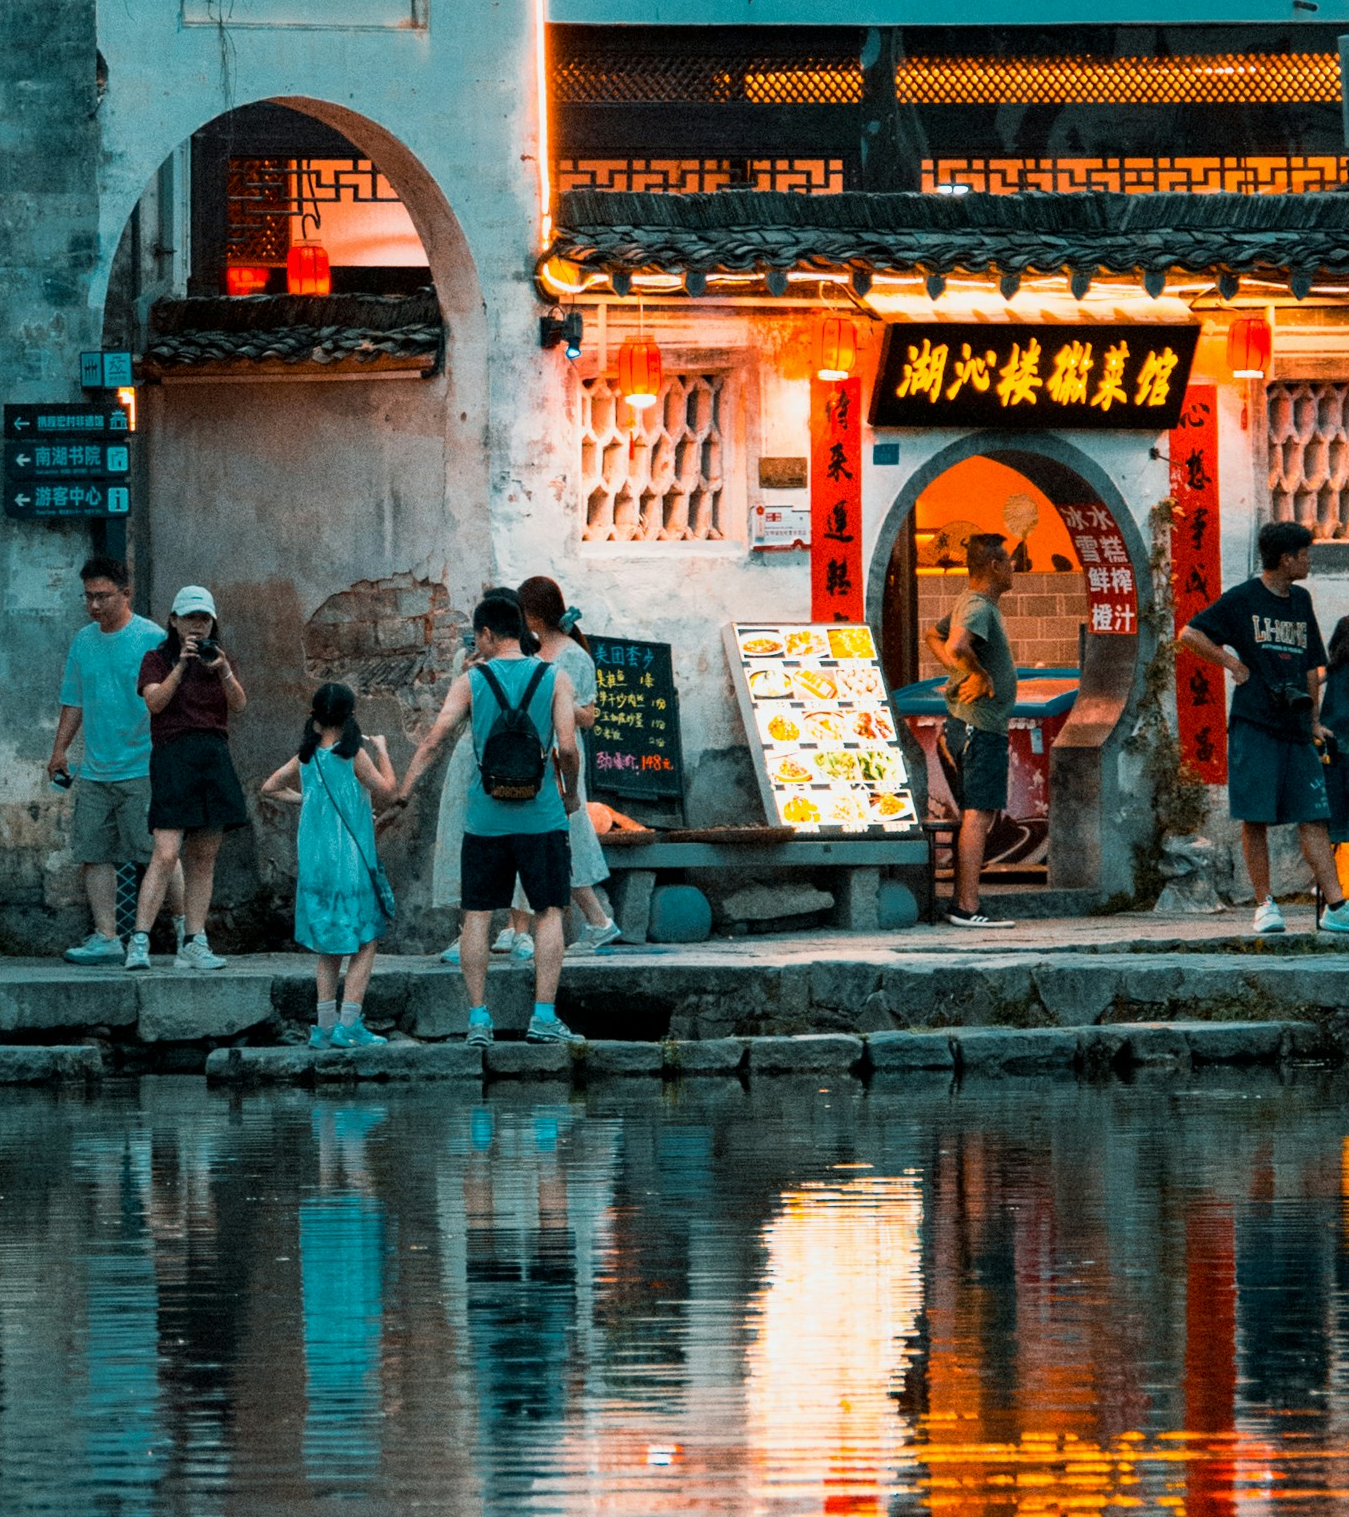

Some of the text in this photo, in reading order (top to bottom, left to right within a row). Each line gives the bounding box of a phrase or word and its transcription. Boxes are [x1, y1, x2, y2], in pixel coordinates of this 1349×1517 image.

[896, 337, 1179, 412] 湖沁楼徽菜馆
[35, 446, 101, 466] 南湖书院
[35, 485, 102, 506] 游客中心
[1059, 506, 1114, 530] 冰水
[1075, 535, 1128, 563] 雪糕
[1088, 567, 1132, 594] 鲜榨
[1092, 603, 1134, 632] 橙汁
